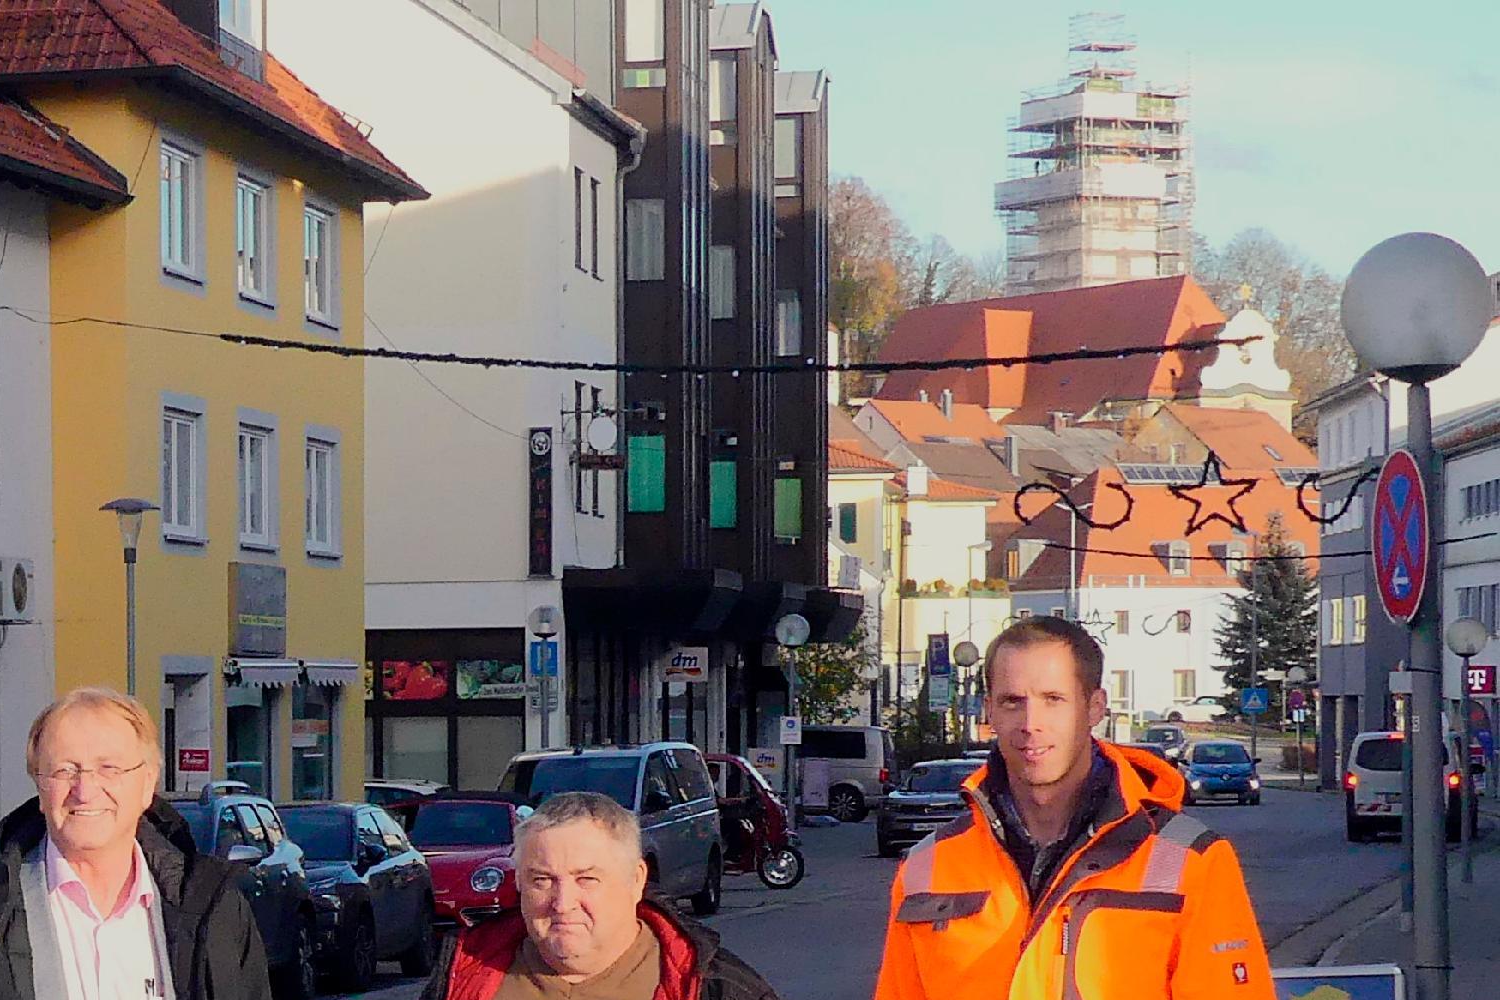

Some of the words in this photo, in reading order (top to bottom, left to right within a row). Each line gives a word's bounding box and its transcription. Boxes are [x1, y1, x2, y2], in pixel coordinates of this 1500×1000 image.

[671, 652, 698, 667] dm
[1467, 669, 1486, 690] T
[757, 753, 775, 763] dm
